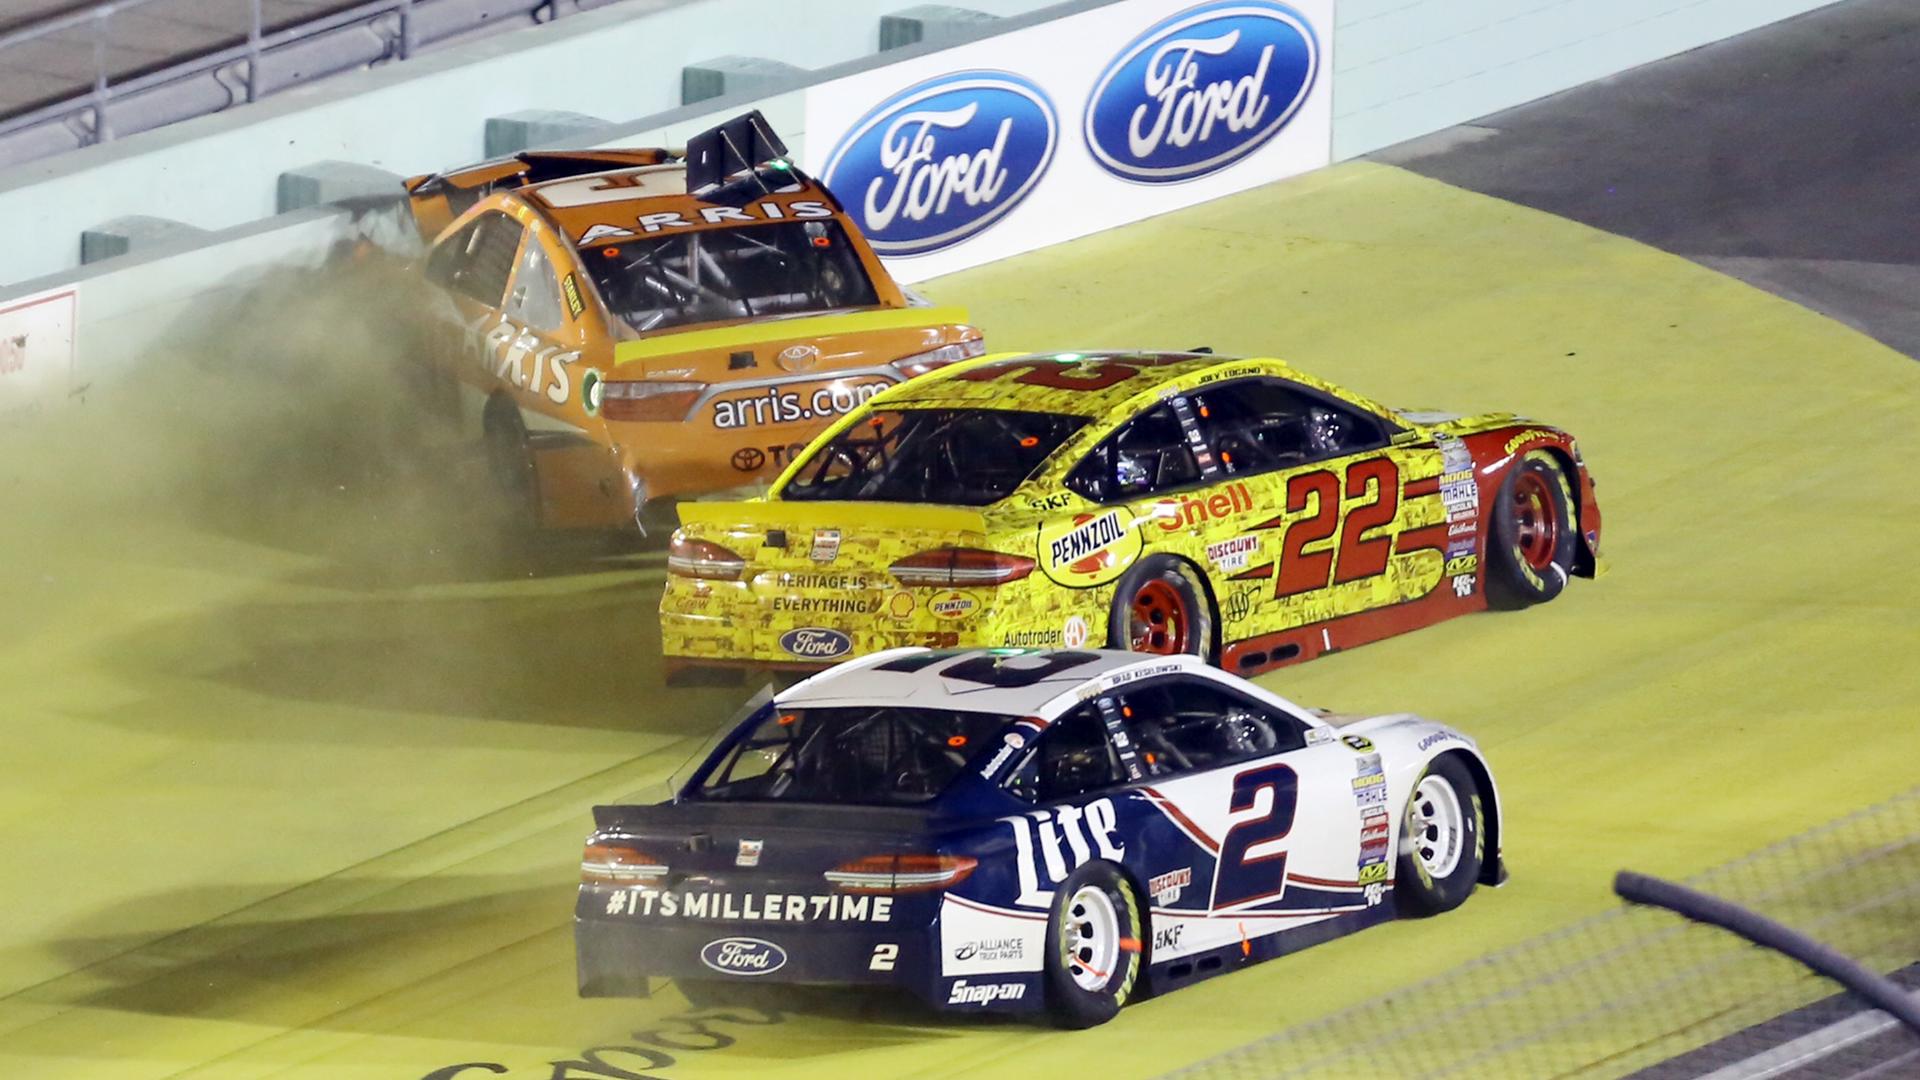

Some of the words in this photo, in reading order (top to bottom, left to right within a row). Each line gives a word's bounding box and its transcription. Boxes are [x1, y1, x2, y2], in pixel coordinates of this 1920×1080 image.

[1128, 29, 1275, 158] Ford
[864, 101, 1012, 231] Ford
[578, 201, 833, 247] ARRIS
[1031, 493, 1072, 511] SKF
[1443, 485, 1476, 501] MAHLE
[1157, 482, 1253, 532] Shell
[1052, 511, 1125, 568] PENNZOIL
[1274, 457, 1399, 600] 22
[1208, 535, 1258, 561] DISCOUNT
[1221, 557, 1243, 569] TIRE
[777, 573, 847, 590] HERITAGE
[852, 576, 868, 590] IS
[773, 597, 867, 614] EVERYTHING
[934, 600, 973, 613] PENNZOIL
[793, 631, 838, 656] Ford
[1004, 628, 1061, 648] Autotrader
[1212, 762, 1299, 912] 2
[995, 798, 1126, 909] Lite
[606, 890, 894, 923] #ITSMILLERTIME
[980, 937, 1023, 950] ALLIANCE
[1154, 924, 1184, 951] SKF
[716, 941, 770, 970] Ford
[868, 943, 899, 971] 2
[1000, 950, 1023, 960] PARTS
[948, 979, 1027, 1006] Snap-on
